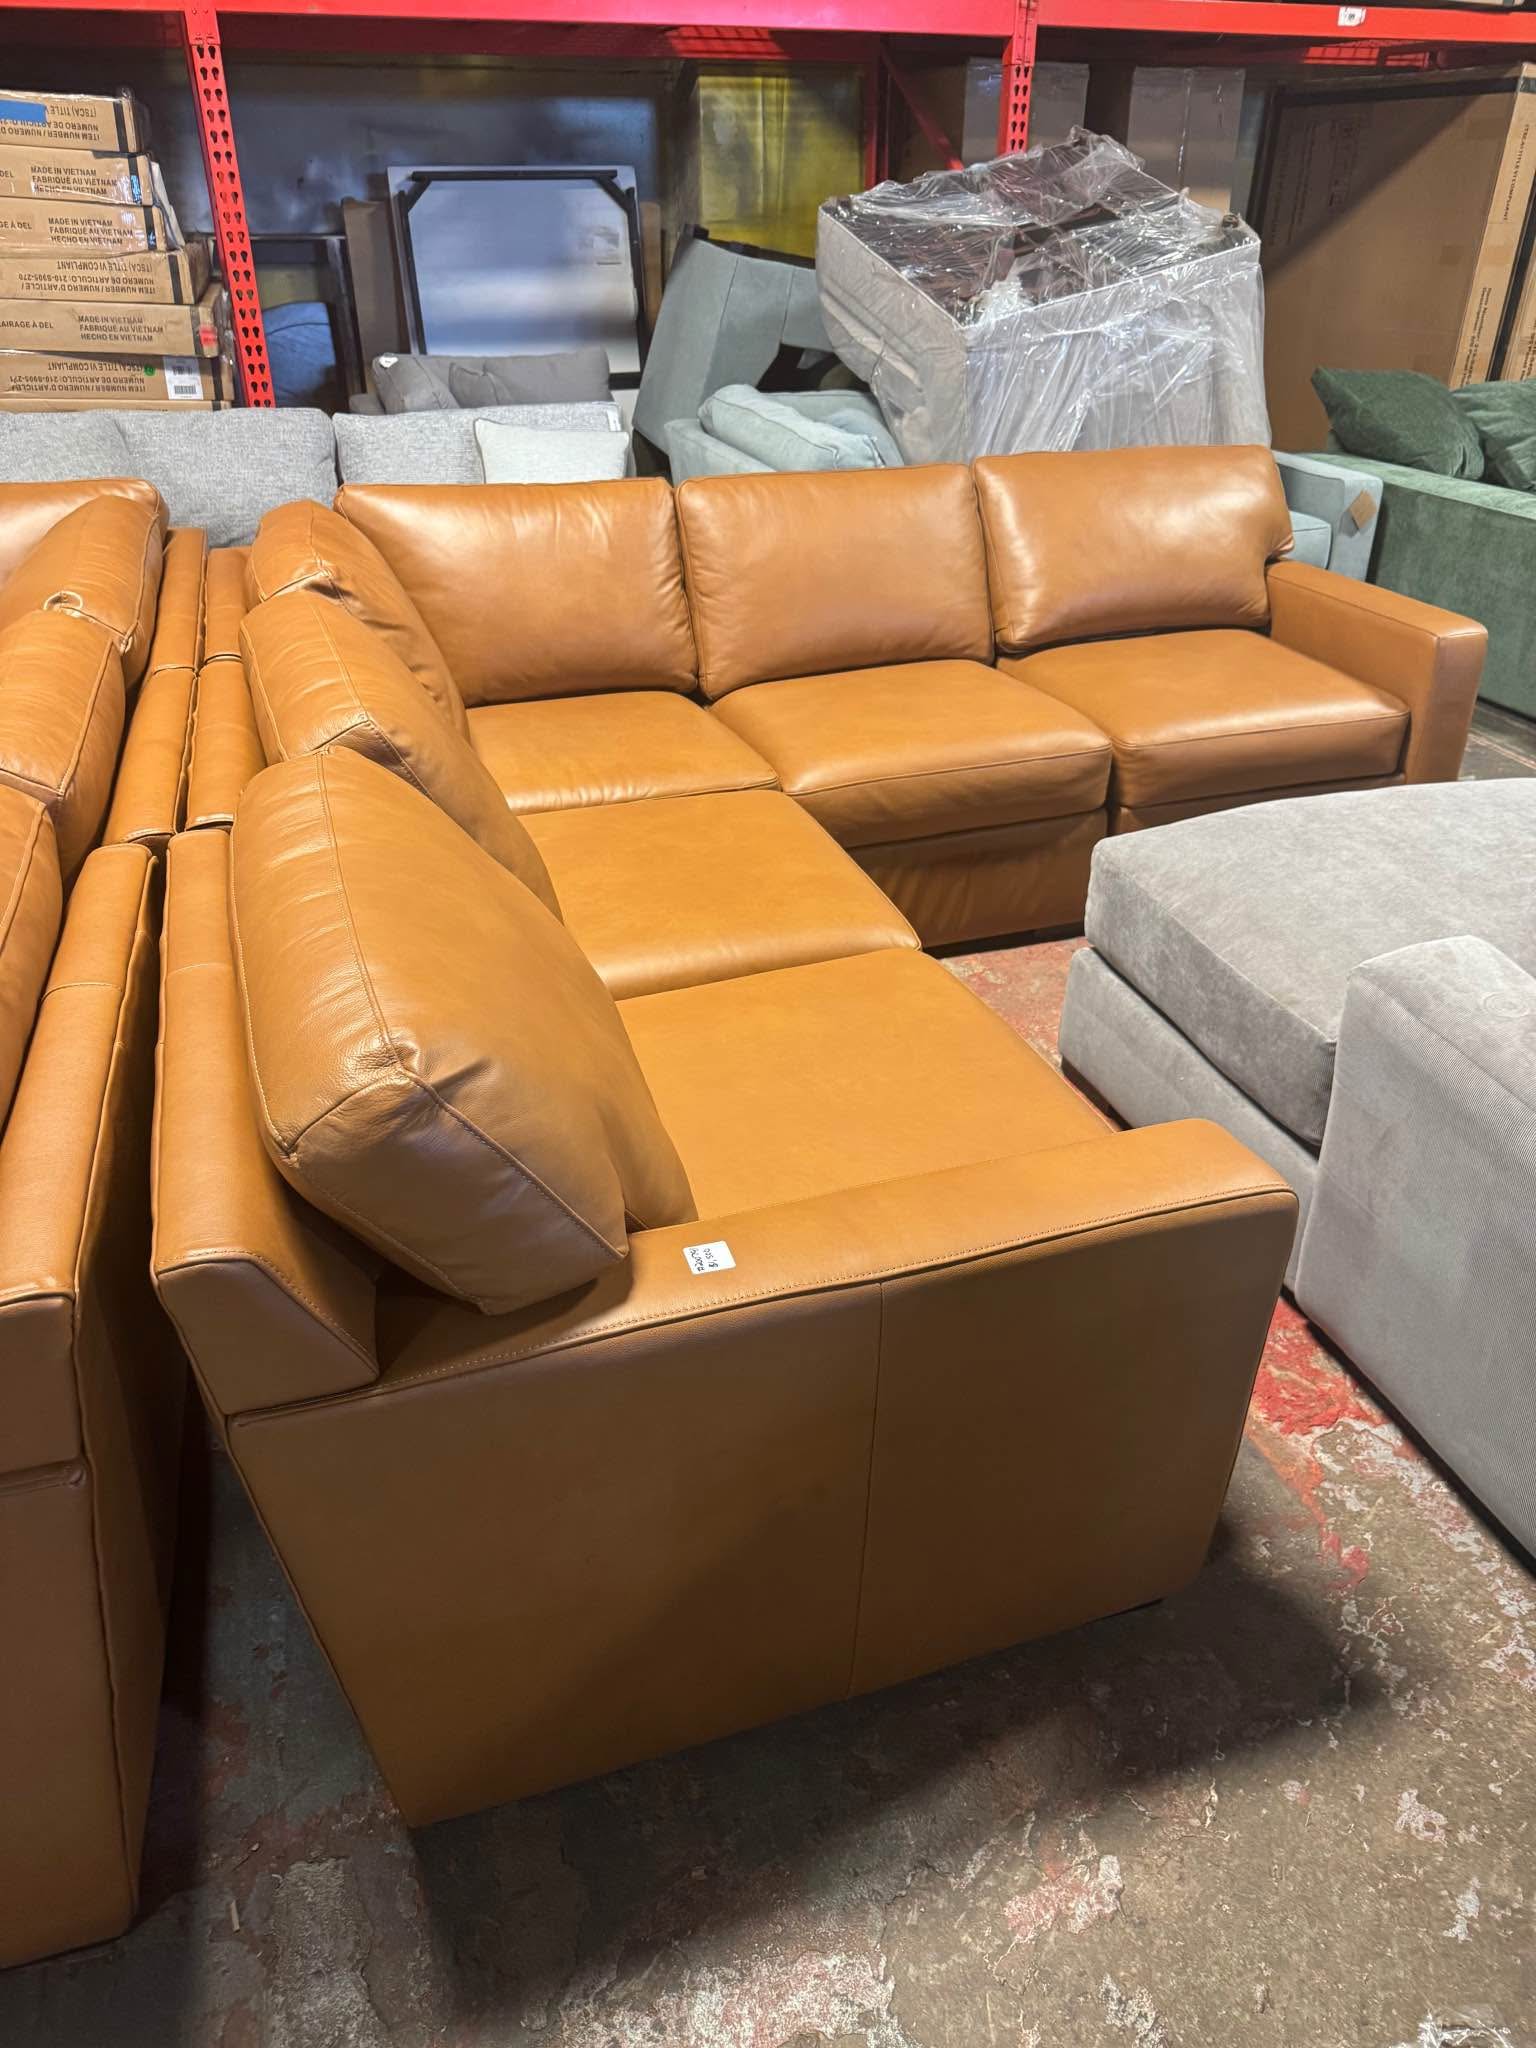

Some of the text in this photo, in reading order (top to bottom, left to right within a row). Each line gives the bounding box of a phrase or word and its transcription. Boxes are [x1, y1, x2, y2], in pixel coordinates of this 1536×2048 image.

[50, 105, 70, 117] TITLE
[53, 121, 64, 129] DE
[47, 130, 80, 139] NUMBER
[81, 132, 100, 141] ITEM
[31, 166, 97, 176] MADE IN VIETNAM
[72, 177, 83, 185] AU
[84, 177, 118, 187] VIETNAM
[17, 222, 32, 230] DEL
[48, 218, 113, 227] MADE IN VIETNAM
[100, 229, 134, 237] VIETNAM
[51, 235, 79, 243] HECHO
[89, 237, 123, 245] VIETNAM
[57, 260, 99, 270] COMPLIANT
[111, 276, 121, 284] DE
[105, 285, 137, 294] NUMBER
[137, 286, 156, 294] ITEM
[78, 315, 99, 323] MADE
[110, 316, 144, 324] VIETNAM
[39, 321, 54, 329] DEL
[131, 326, 164, 334] VIETNAM
[81, 333, 108, 341] HECHO
[120, 334, 153, 342] VIETNAM
[48, 361, 89, 371] COMPLIANT
[101, 376, 112, 384] DE
